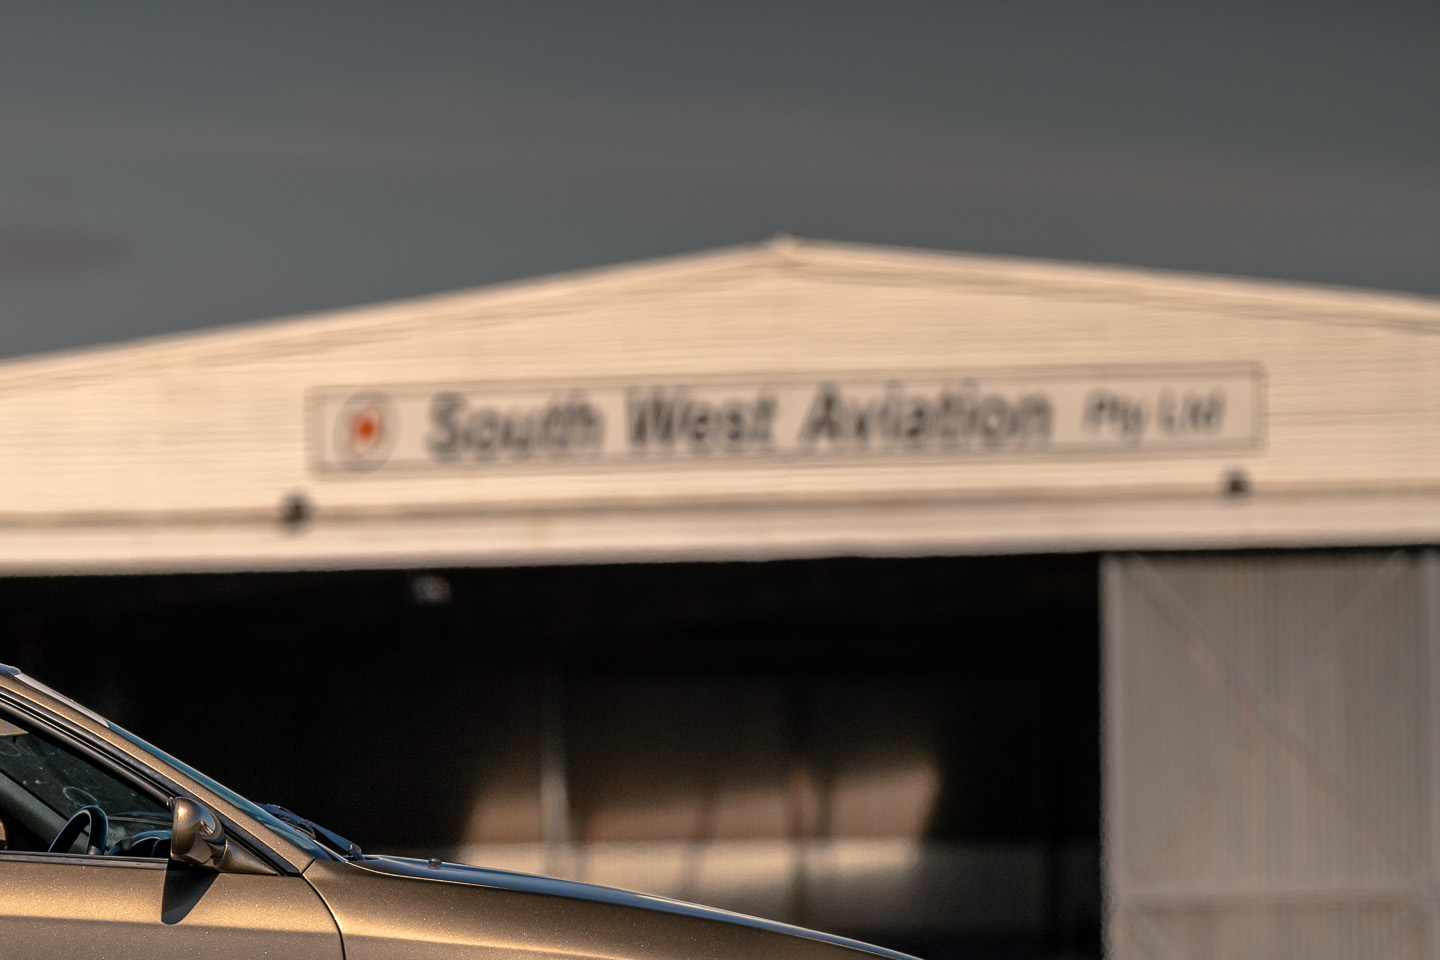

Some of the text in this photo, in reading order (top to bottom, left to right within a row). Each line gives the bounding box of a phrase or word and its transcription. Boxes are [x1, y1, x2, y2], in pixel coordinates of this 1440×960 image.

[426, 380, 1228, 458] South West Aviation Pty Ltd
